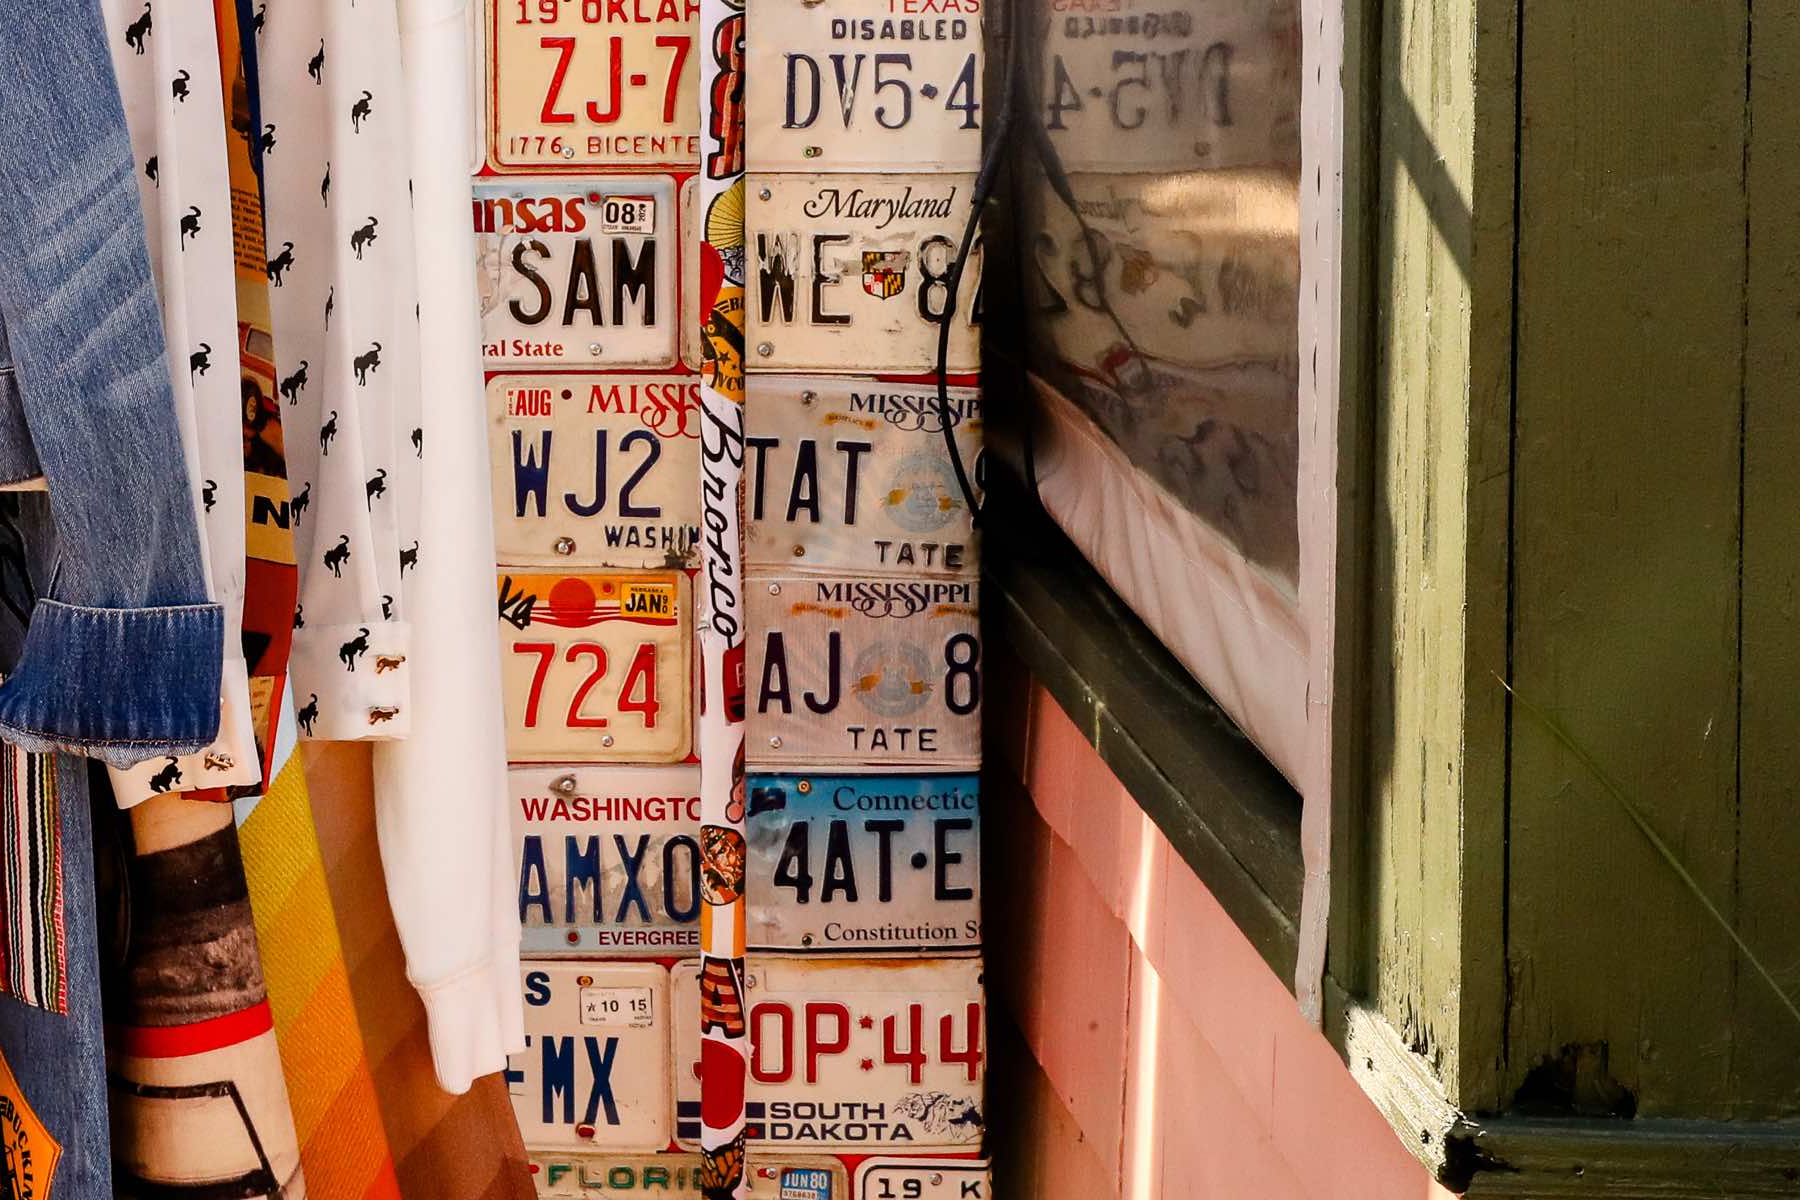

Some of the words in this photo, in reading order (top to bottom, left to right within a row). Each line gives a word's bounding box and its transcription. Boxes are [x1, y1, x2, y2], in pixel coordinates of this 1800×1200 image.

[831, 18, 968, 41] DISABLED
[540, 36, 691, 124] ZJ-7
[509, 135, 564, 156] 1776
[605, 202, 635, 224] 08
[803, 187, 958, 230] Maryland
[509, 237, 656, 327] SAM
[755, 234, 852, 326] WE
[512, 339, 564, 358] State
[515, 389, 552, 416] AUG
[874, 540, 964, 568] TATE
[625, 593, 662, 613] JAN
[817, 583, 971, 618] MISSISSIPPI
[758, 631, 842, 715] AJ
[512, 642, 659, 729] 724
[847, 728, 938, 752] TATE
[823, 922, 959, 941] Constitution
[601, 1000, 620, 1012] 10
[629, 998, 648, 1012] 15
[770, 1102, 886, 1121] SOUTH
[770, 1123, 915, 1141] DAKOTA
[878, 1178, 922, 1198] 19
